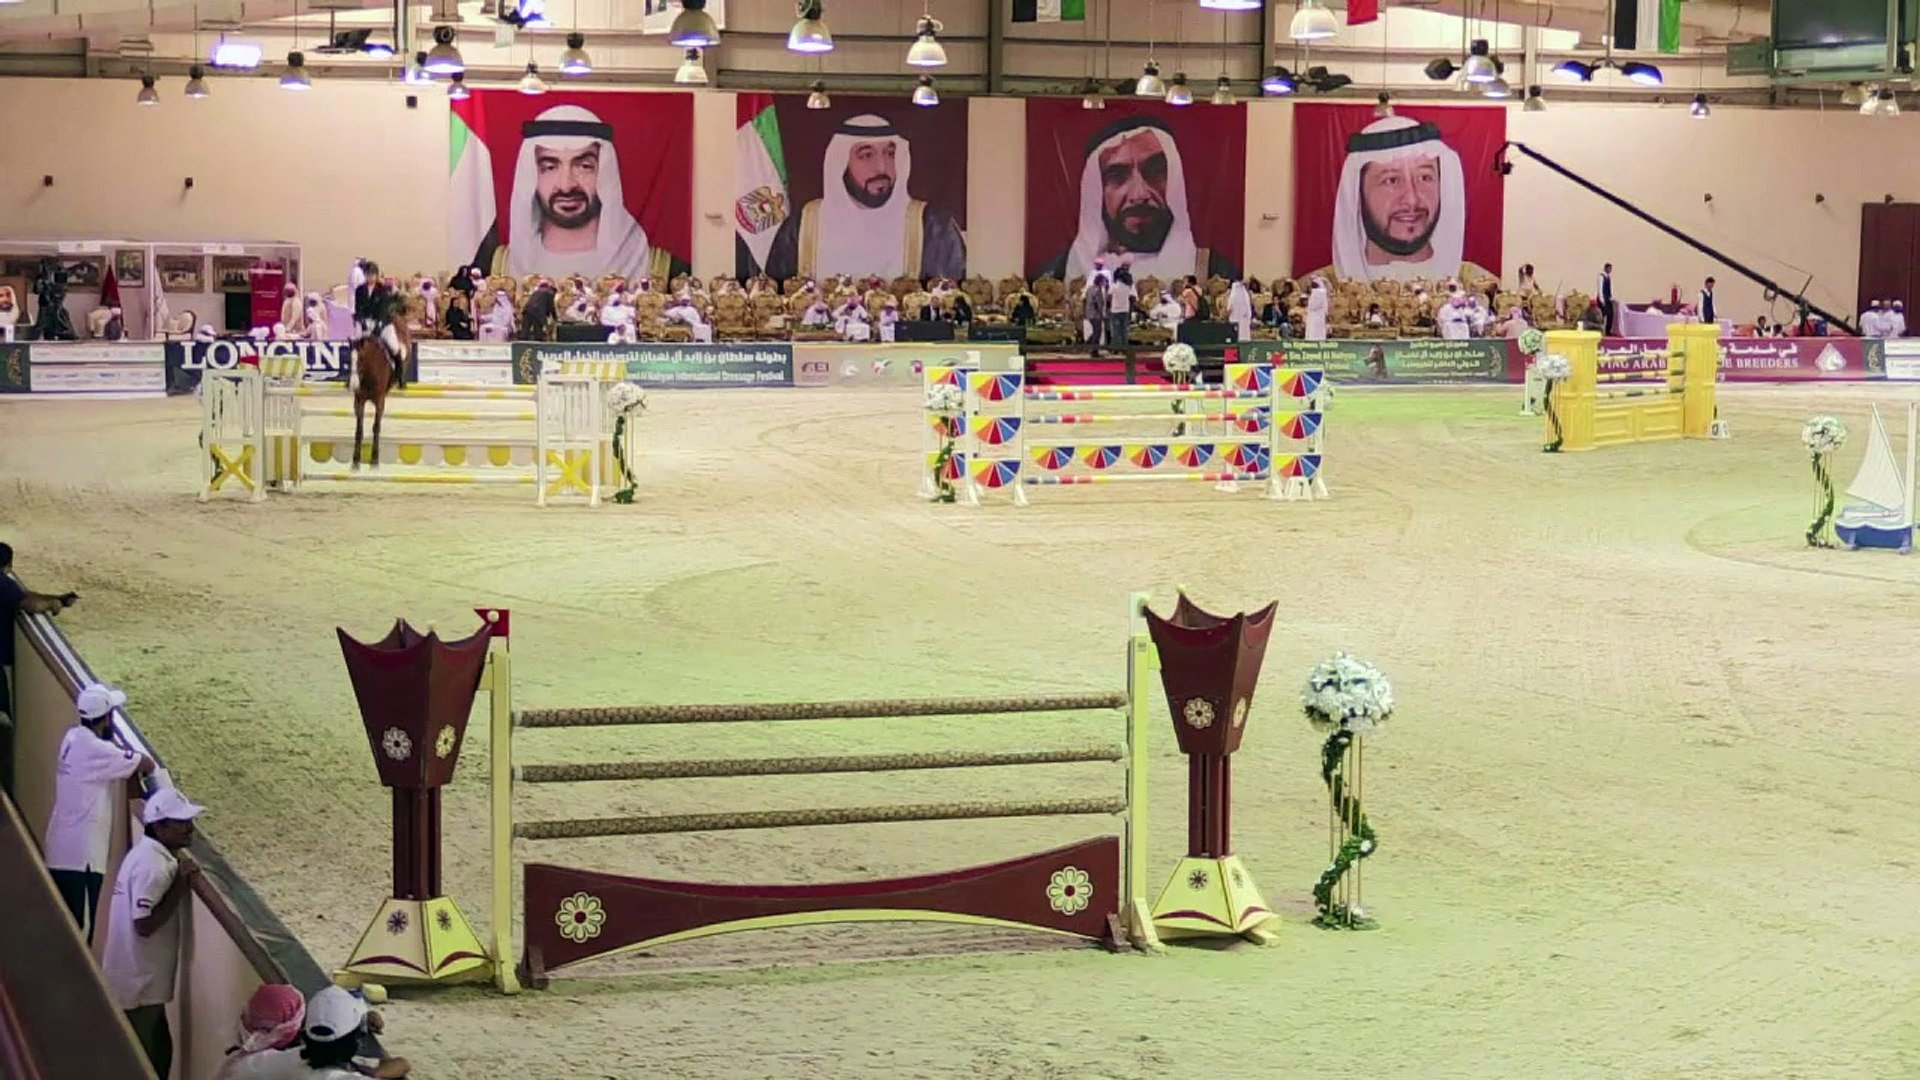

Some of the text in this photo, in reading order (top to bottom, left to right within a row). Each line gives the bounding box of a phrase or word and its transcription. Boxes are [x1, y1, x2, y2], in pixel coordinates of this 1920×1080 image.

[1728, 342, 1777, 354] خدمة
[1778, 342, 1797, 358] في
[180, 340, 349, 370] LONGIN
[703, 351, 717, 364] بن
[718, 351, 754, 364] سلطان
[754, 350, 787, 364] بطولة
[1600, 359, 1667, 369] VING ARAB
[1736, 358, 1799, 369] BREEDERS
